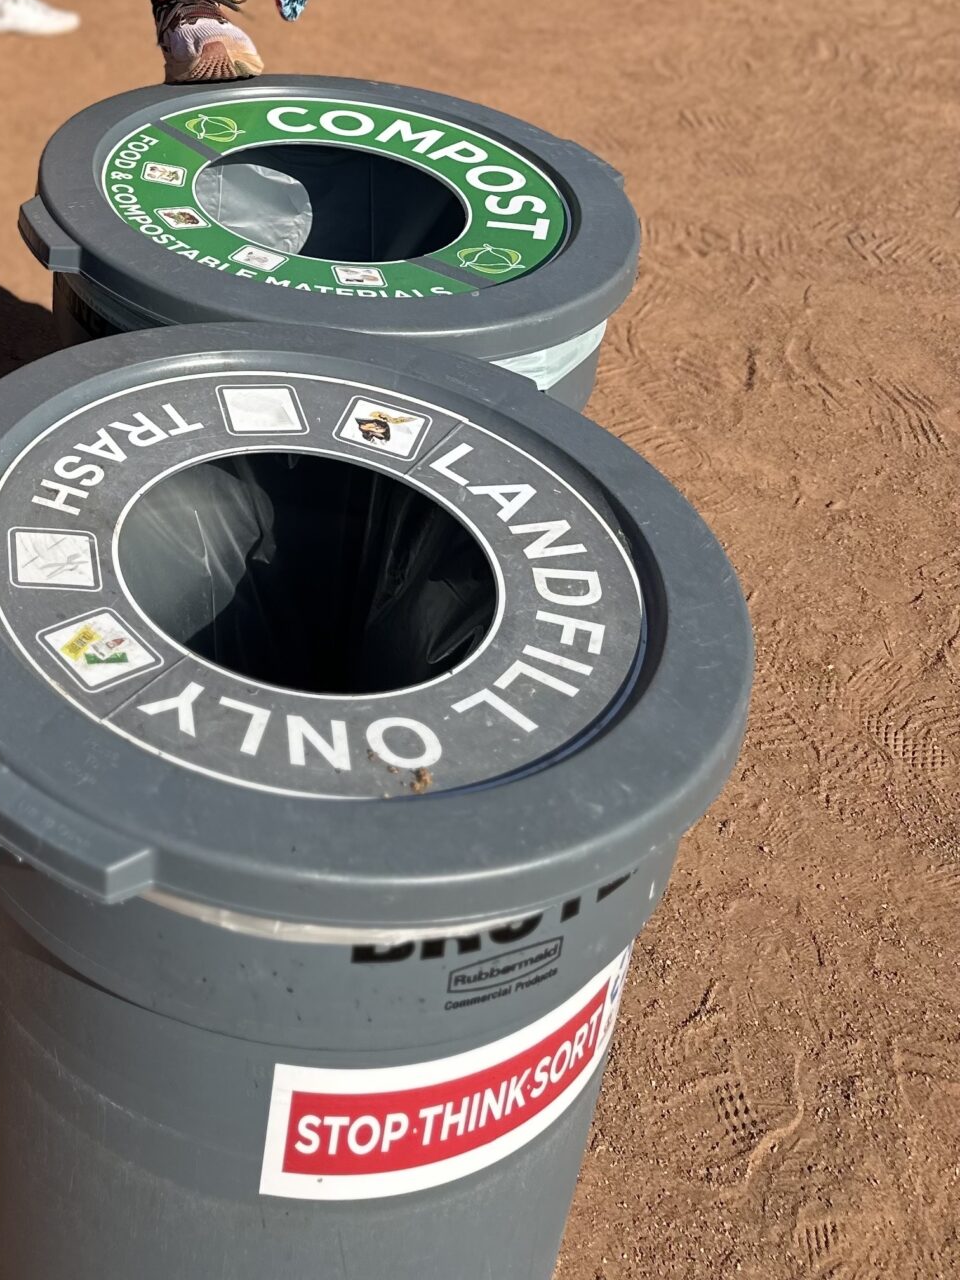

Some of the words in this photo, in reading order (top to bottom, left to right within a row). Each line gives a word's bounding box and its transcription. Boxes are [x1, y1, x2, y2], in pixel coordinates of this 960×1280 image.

[110, 171, 133, 180] &
[114, 134, 159, 169] FOOD
[266, 106, 550, 240] COMPOST
[31, 402, 204, 516] TRASH
[428, 442, 605, 734] LANDFILL
[137, 680, 442, 771] ONLY
[444, 985, 512, 1011] Commercial
[514, 967, 558, 993] Products
[453, 943, 559, 987] Rubbermaid
[294, 1113, 409, 1155] STOP
[418, 1068, 535, 1146] THINK
[529, 1002, 605, 1099] SORT
